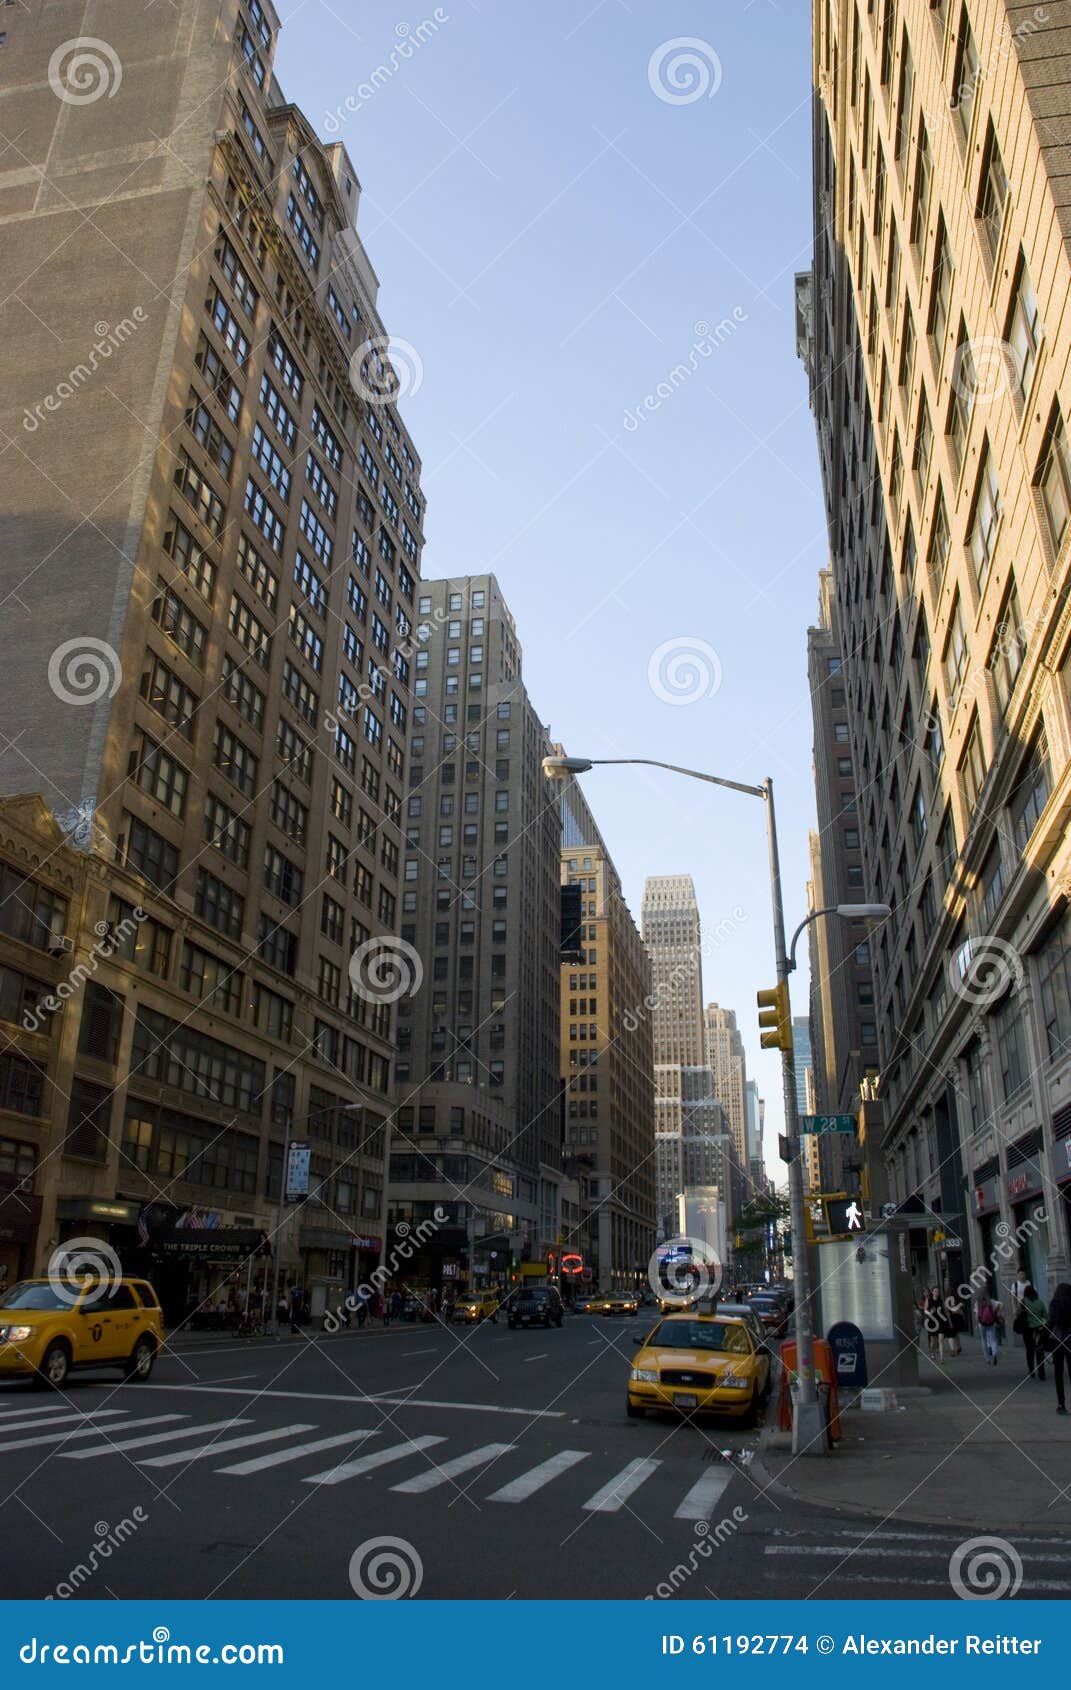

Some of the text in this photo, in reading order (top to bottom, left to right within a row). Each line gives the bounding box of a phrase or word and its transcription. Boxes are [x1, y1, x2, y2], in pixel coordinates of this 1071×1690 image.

[804, 1116, 815, 1131] W
[820, 1116, 837, 1131] 28
[163, 1243, 240, 1253] THE TRIPLE CROWN
